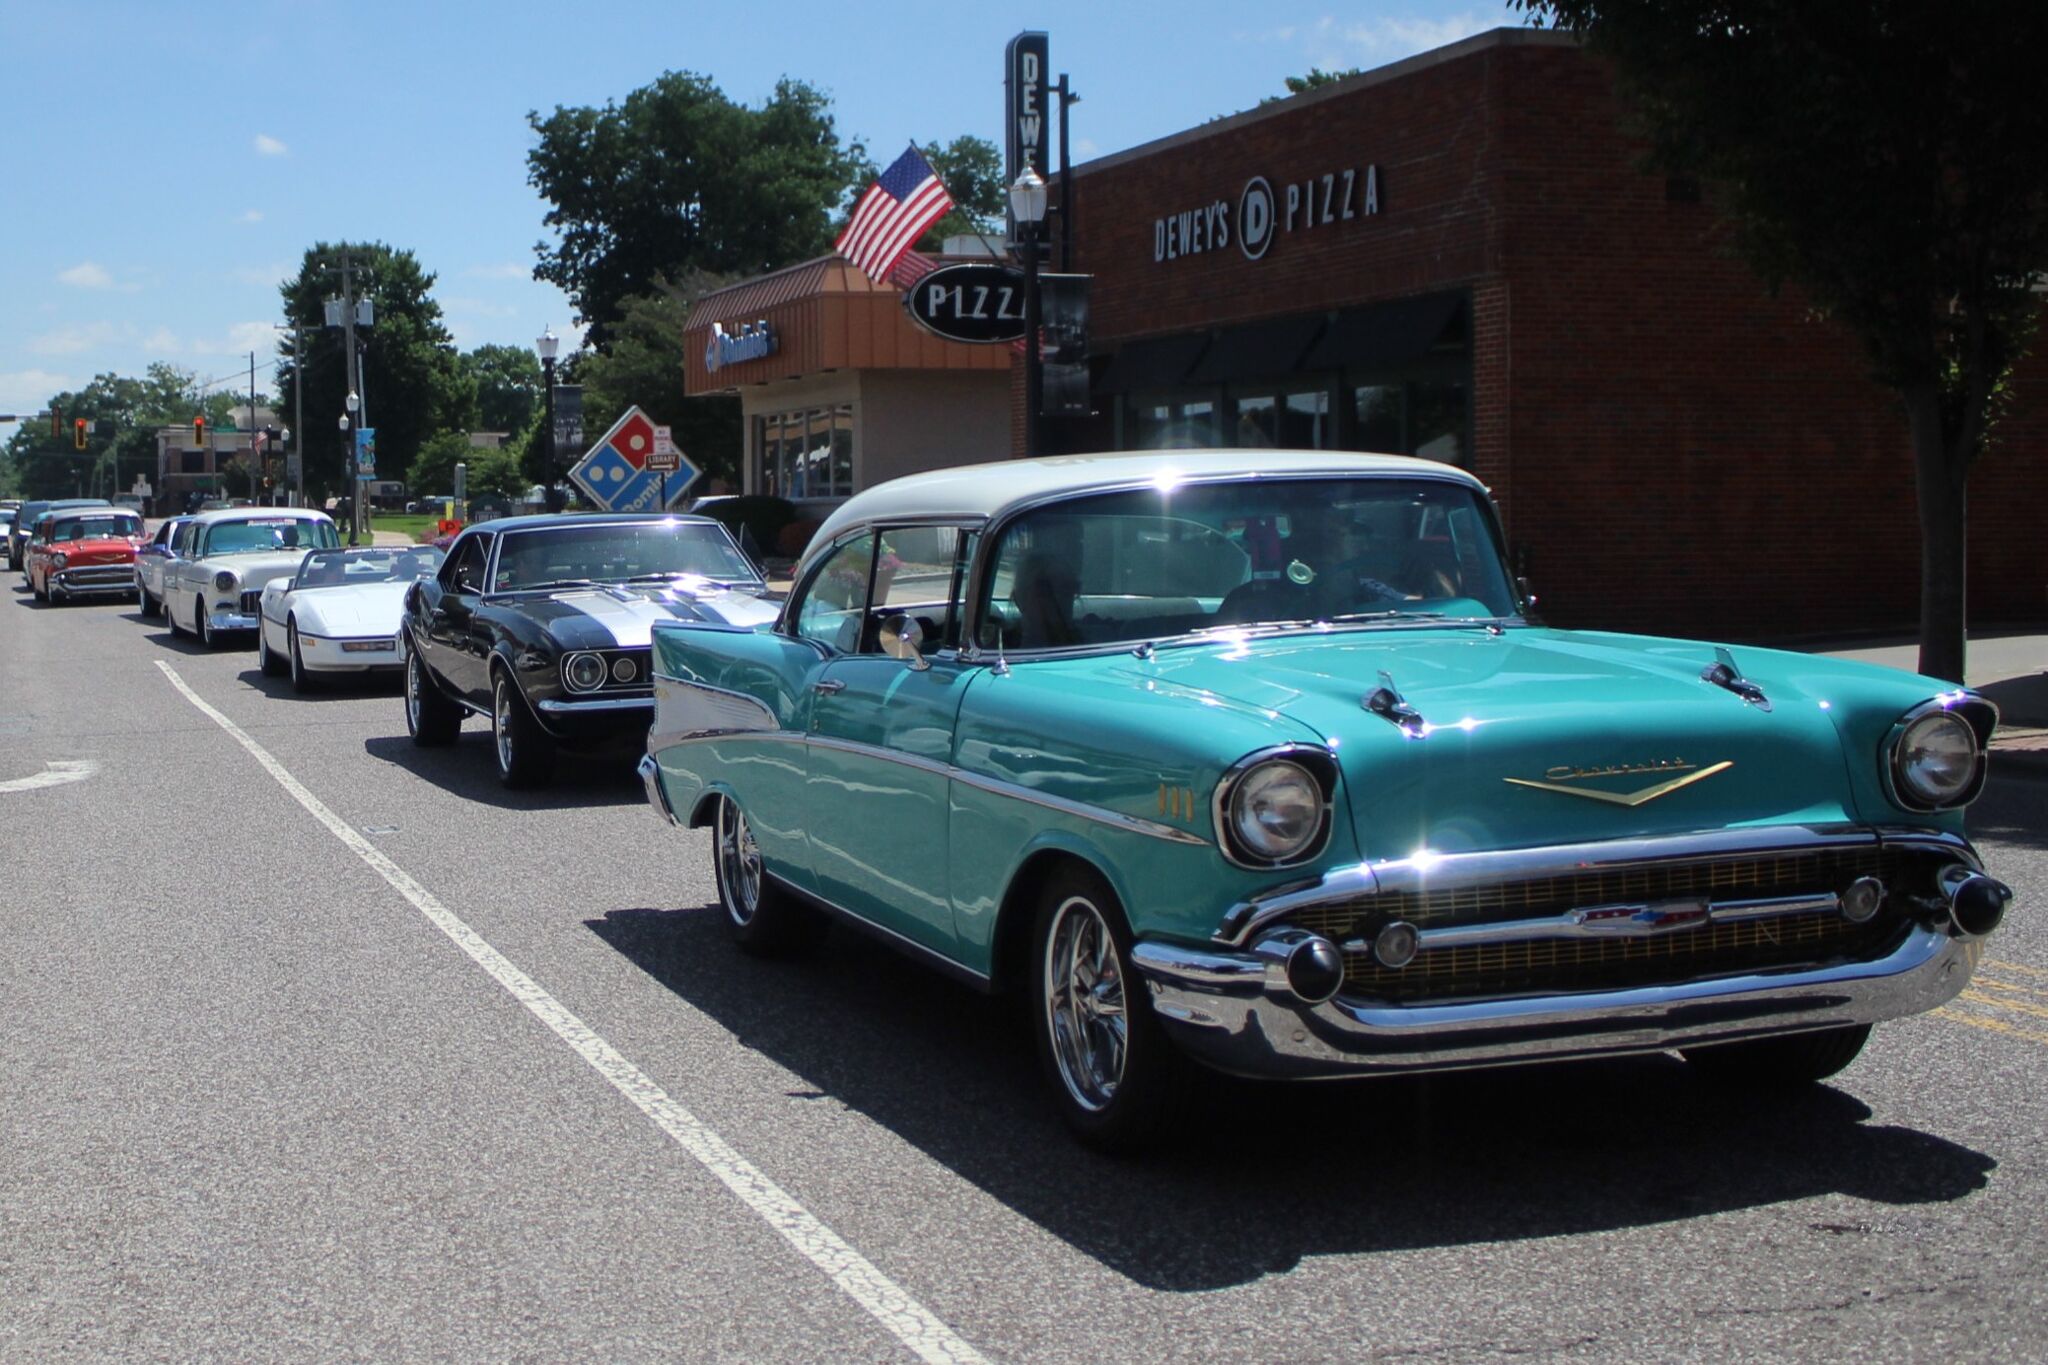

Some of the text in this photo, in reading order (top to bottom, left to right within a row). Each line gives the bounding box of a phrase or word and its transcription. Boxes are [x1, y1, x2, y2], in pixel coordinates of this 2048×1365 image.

[1155, 164, 1378, 262] DEWEY'S D PIZZA
[648, 454, 677, 464] LIBRARY
